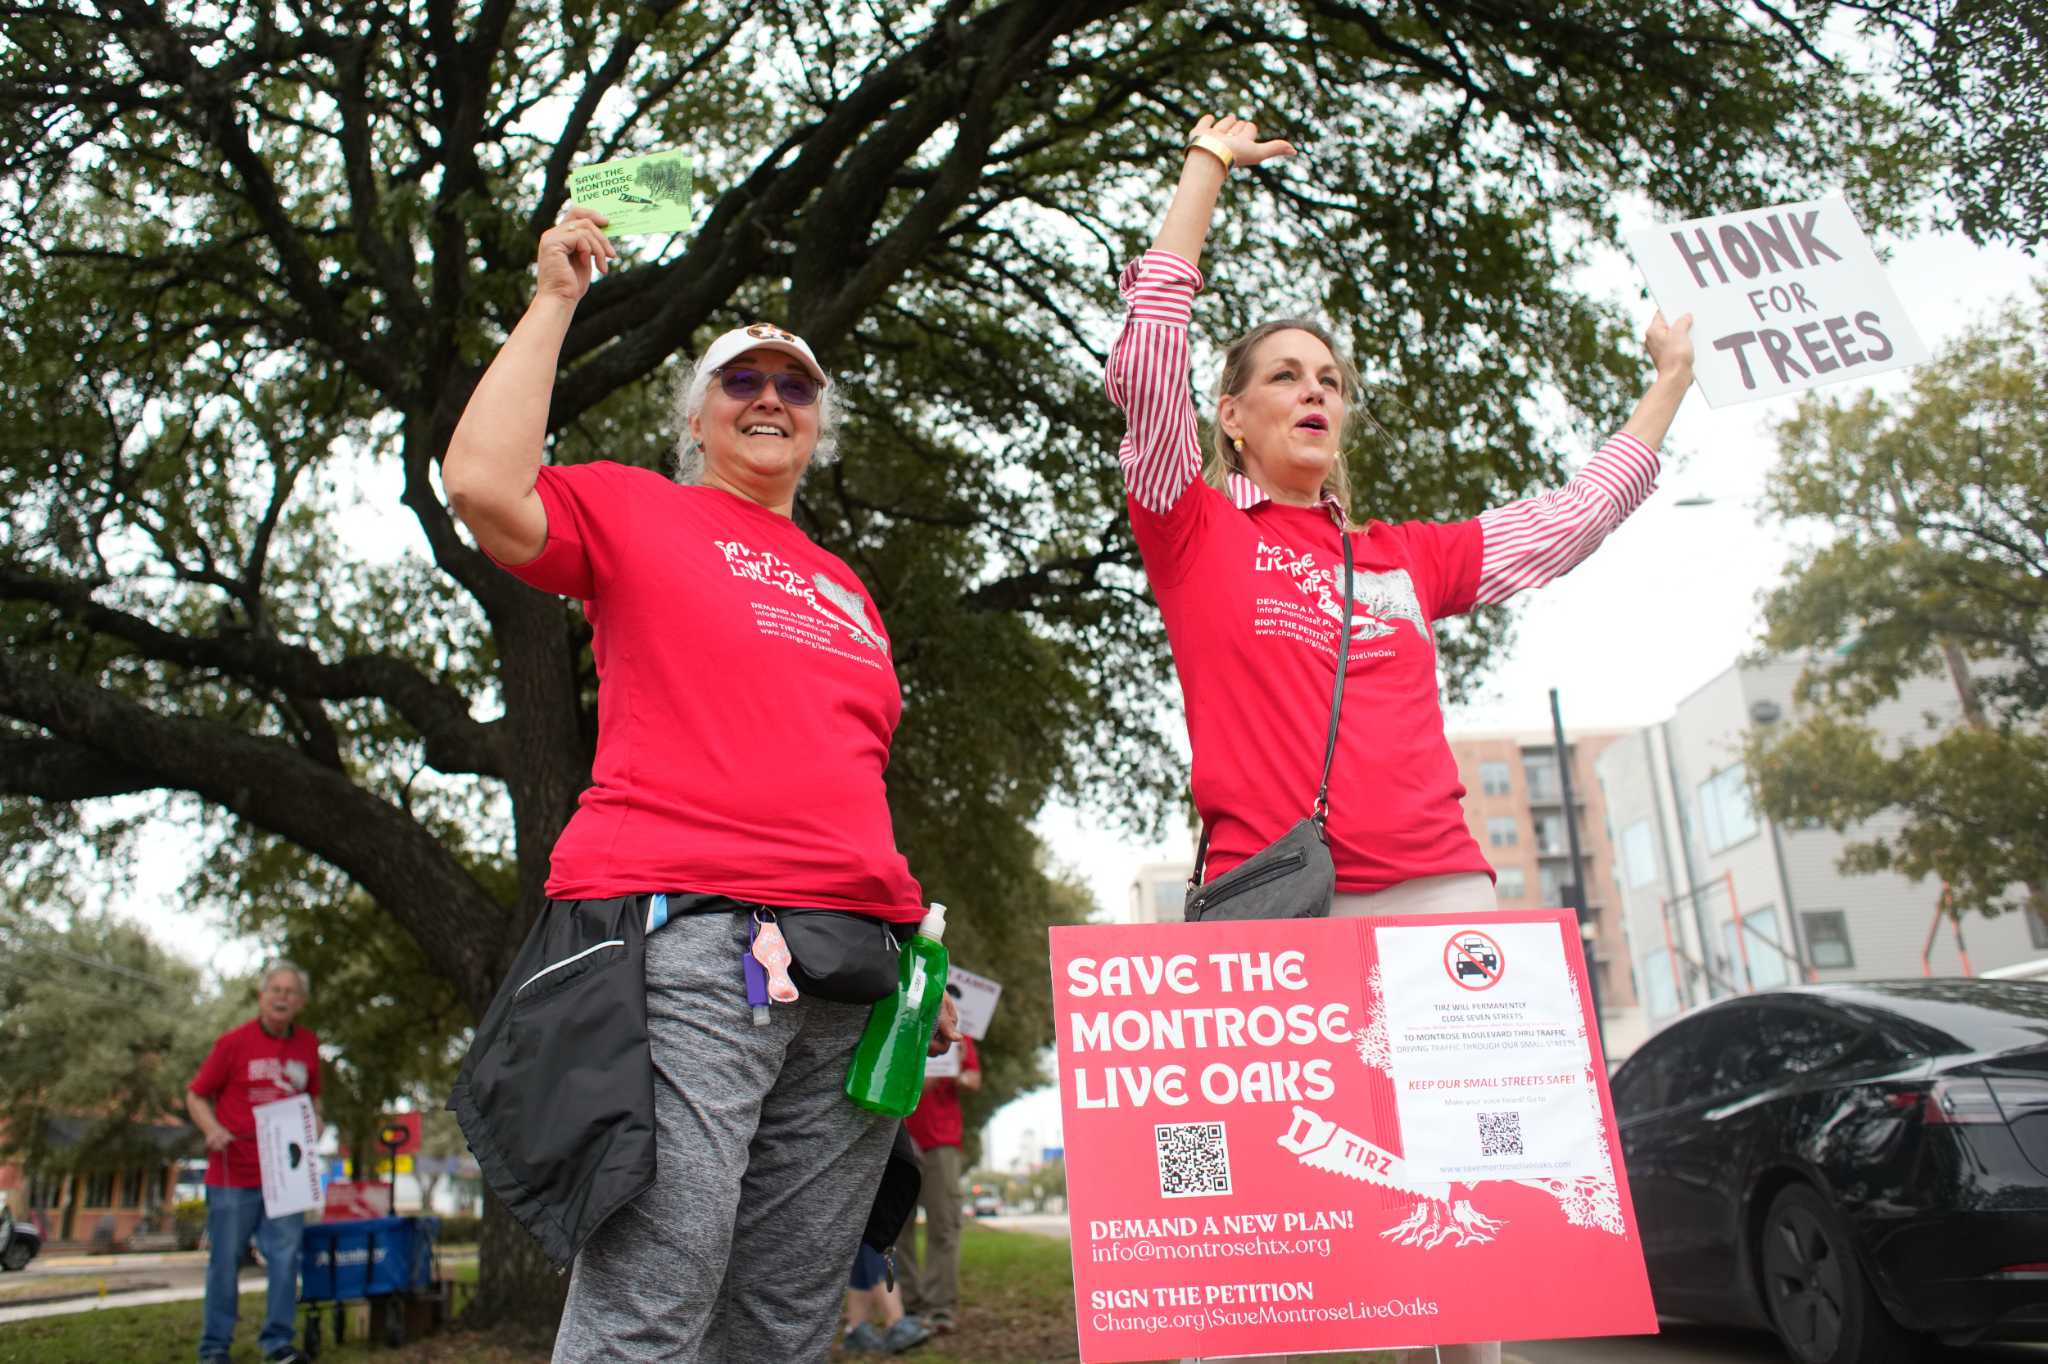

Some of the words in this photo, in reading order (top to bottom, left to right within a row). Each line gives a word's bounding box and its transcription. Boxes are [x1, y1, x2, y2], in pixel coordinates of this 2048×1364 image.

[575, 173, 602, 185] SAVE
[604, 167, 624, 178] THE
[576, 174, 633, 194] MONTROSE
[577, 192, 600, 203] LIVE
[602, 184, 630, 197] OAKS
[1670, 210, 1843, 288] HONK
[1747, 282, 1818, 322] FOR
[1712, 310, 1893, 390] TREES
[1256, 598, 1298, 609] DEMAND
[1279, 620, 1297, 630] THE
[1067, 955, 1200, 997] SAVE
[1209, 951, 1309, 992] THE
[1070, 1003, 1353, 1053] MONTROSE
[1441, 1014, 1465, 1022] CLOSE
[1466, 1013, 1491, 1021] SEVEN
[1492, 1012, 1523, 1020] STREETS
[1404, 1033, 1414, 1041] TO
[1416, 1032, 1461, 1041] MONTROSE
[1536, 1029, 1567, 1037] TRAFFIC
[1074, 1064, 1189, 1109] LIVE
[1200, 1059, 1336, 1105] OAKS
[1408, 1080, 1435, 1090] KEEP
[1437, 1079, 1461, 1089] OUR
[1464, 1078, 1498, 1089] SMALL
[1501, 1076, 1544, 1087] STREETS
[1547, 1074, 1576, 1085] SAFE!
[1344, 1140, 1393, 1177] TIRZ
[1090, 1217, 1198, 1240] DEMAND
[1203, 1216, 1220, 1236] A
[1223, 1213, 1279, 1235] NEW
[1283, 1210, 1354, 1233] PLAN!
[1092, 1237, 1331, 1263] info@montrosehtx.org
[1091, 1288, 1149, 1310] SIGN
[1152, 1286, 1202, 1308] THE
[1205, 1282, 1314, 1305] PETITION
[1093, 1297, 1439, 1334] Change.org\SaveMontroseLiveOaks
